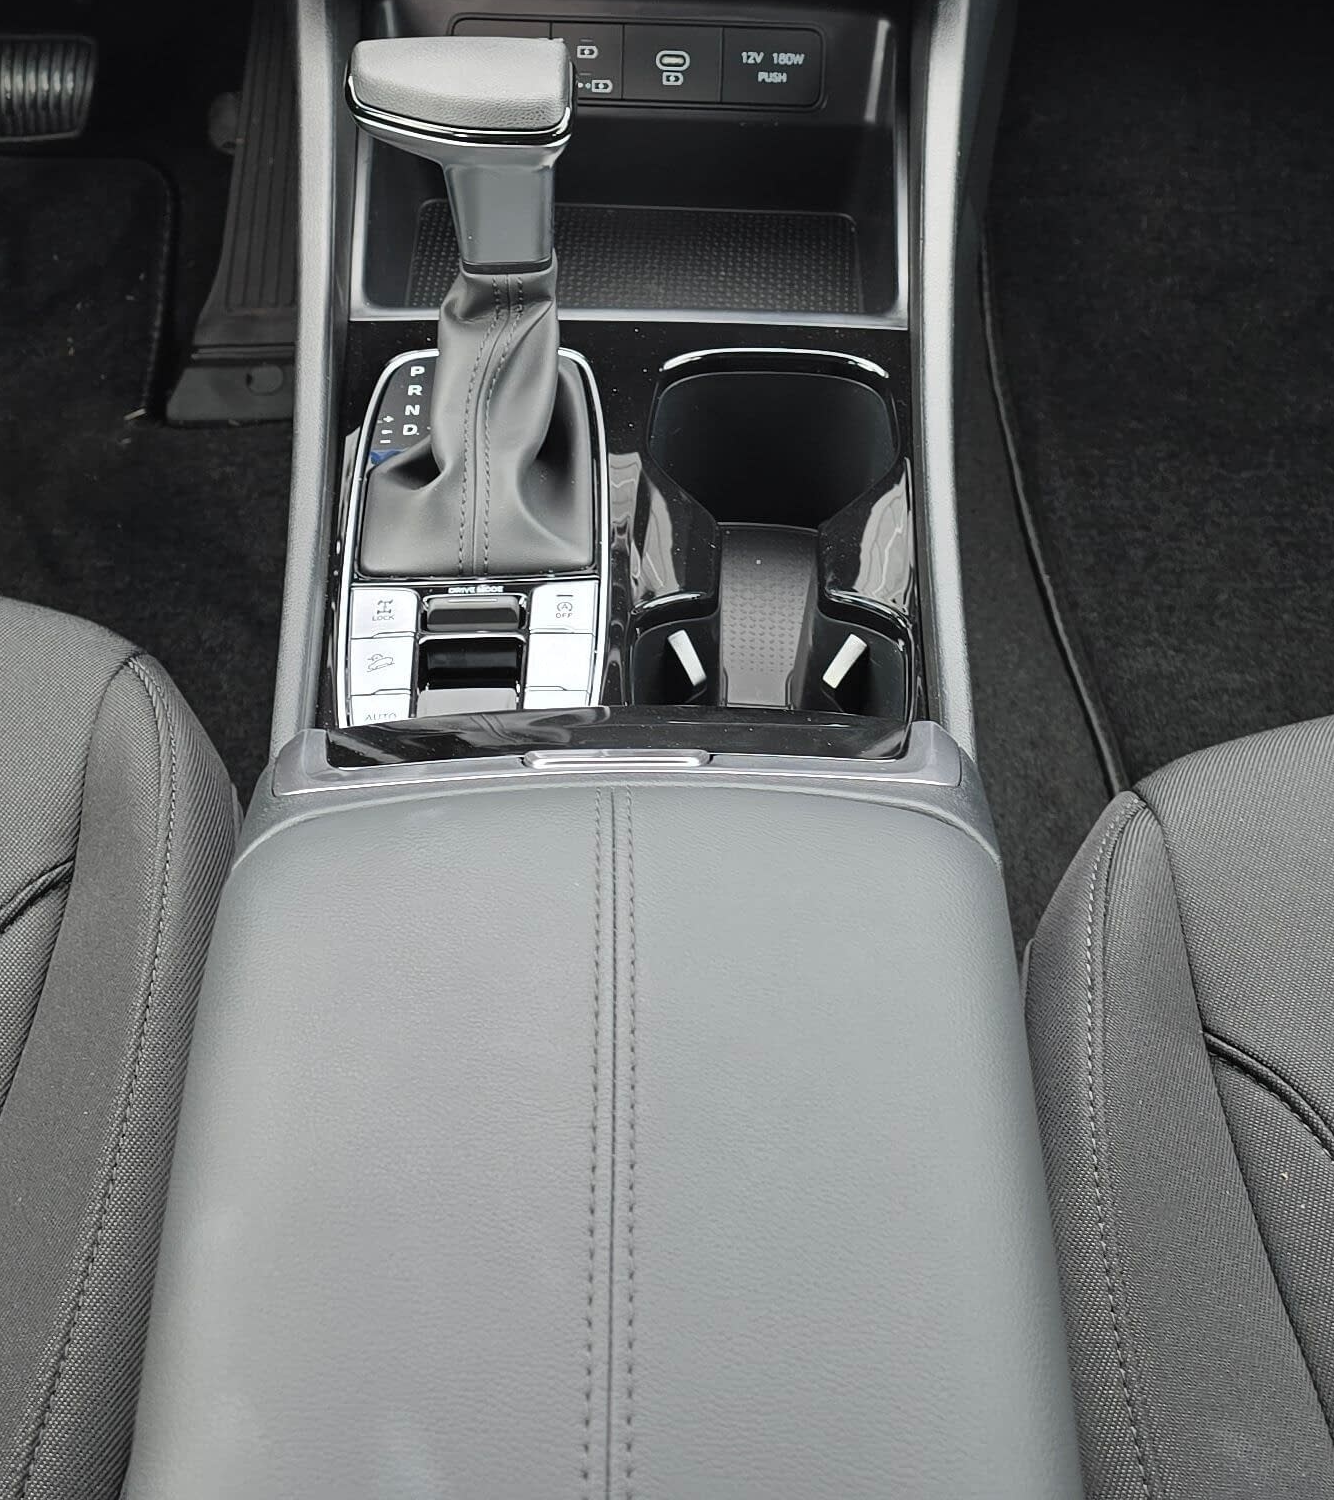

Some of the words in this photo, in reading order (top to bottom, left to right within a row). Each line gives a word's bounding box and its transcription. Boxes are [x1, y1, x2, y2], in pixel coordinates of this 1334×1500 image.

[741, 51, 765, 64] 12V
[772, 52, 805, 66] 180W
[757, 71, 788, 83] PUSH
[410, 366, 425, 377] P
[407, 384, 423, 396] R
[404, 404, 421, 416] N
